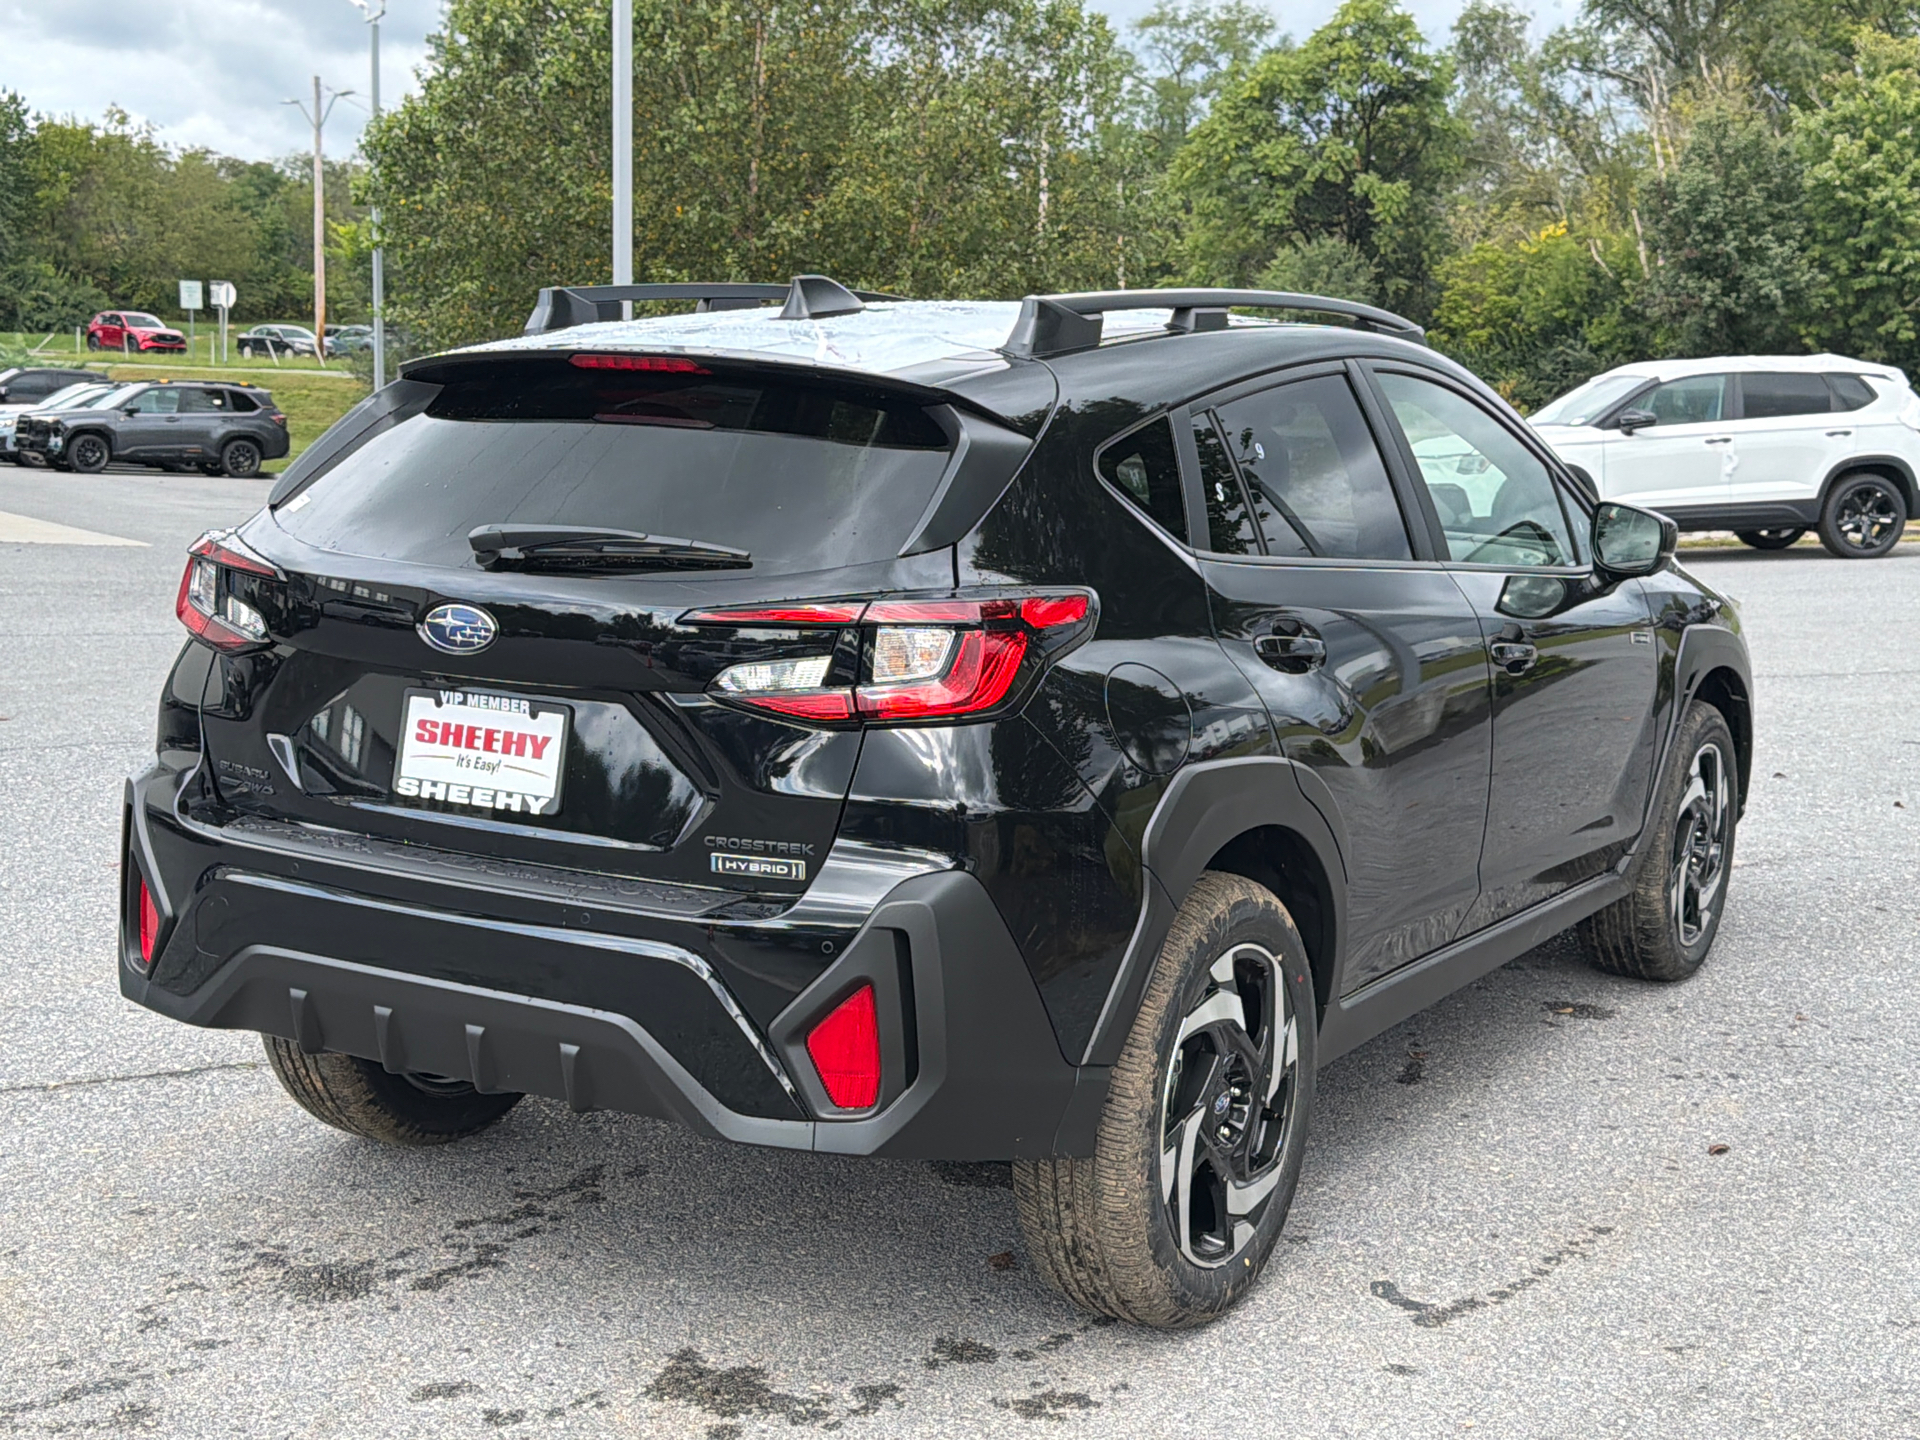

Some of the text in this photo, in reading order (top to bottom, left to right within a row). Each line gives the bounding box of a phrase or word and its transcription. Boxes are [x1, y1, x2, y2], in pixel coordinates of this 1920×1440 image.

[440, 690, 531, 714] VIP MEMBER
[415, 718, 552, 760] SHEEHY
[220, 760, 271, 779] SUBARU
[456, 753, 502, 775] It's Easy!
[397, 777, 550, 815] SHEEHY
[704, 835, 815, 856] CROSSTREK
[725, 861, 788, 874] HYBRID
